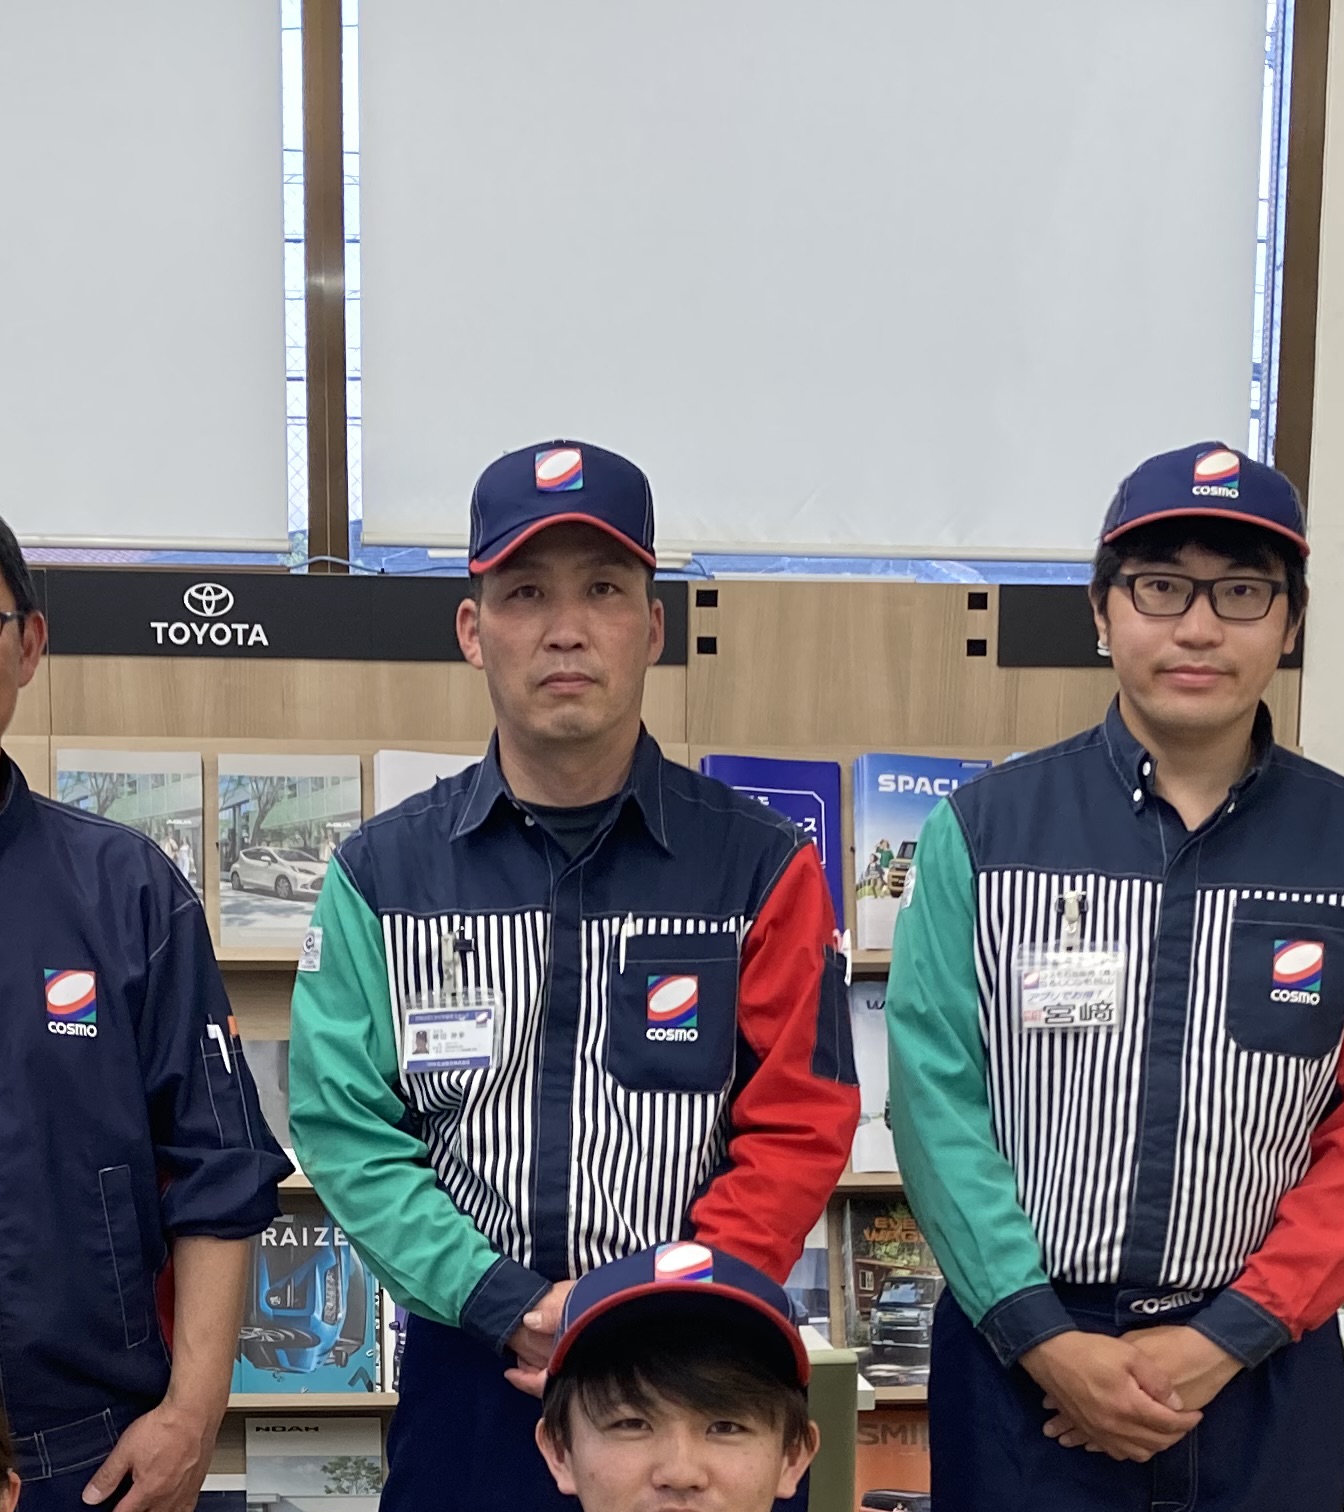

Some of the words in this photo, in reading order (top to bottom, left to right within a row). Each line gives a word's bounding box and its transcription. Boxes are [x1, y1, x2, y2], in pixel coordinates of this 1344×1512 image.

[1192, 485, 1239, 499] COSMO
[150, 621, 269, 647] TOYOTA
[877, 773, 959, 797] SPACI
[1269, 988, 1321, 1006] COSMO
[47, 1021, 98, 1038] COSMO
[645, 1027, 699, 1042] COSMO
[261, 1226, 349, 1247] RAIZE
[1129, 1288, 1205, 1315] COSMO
